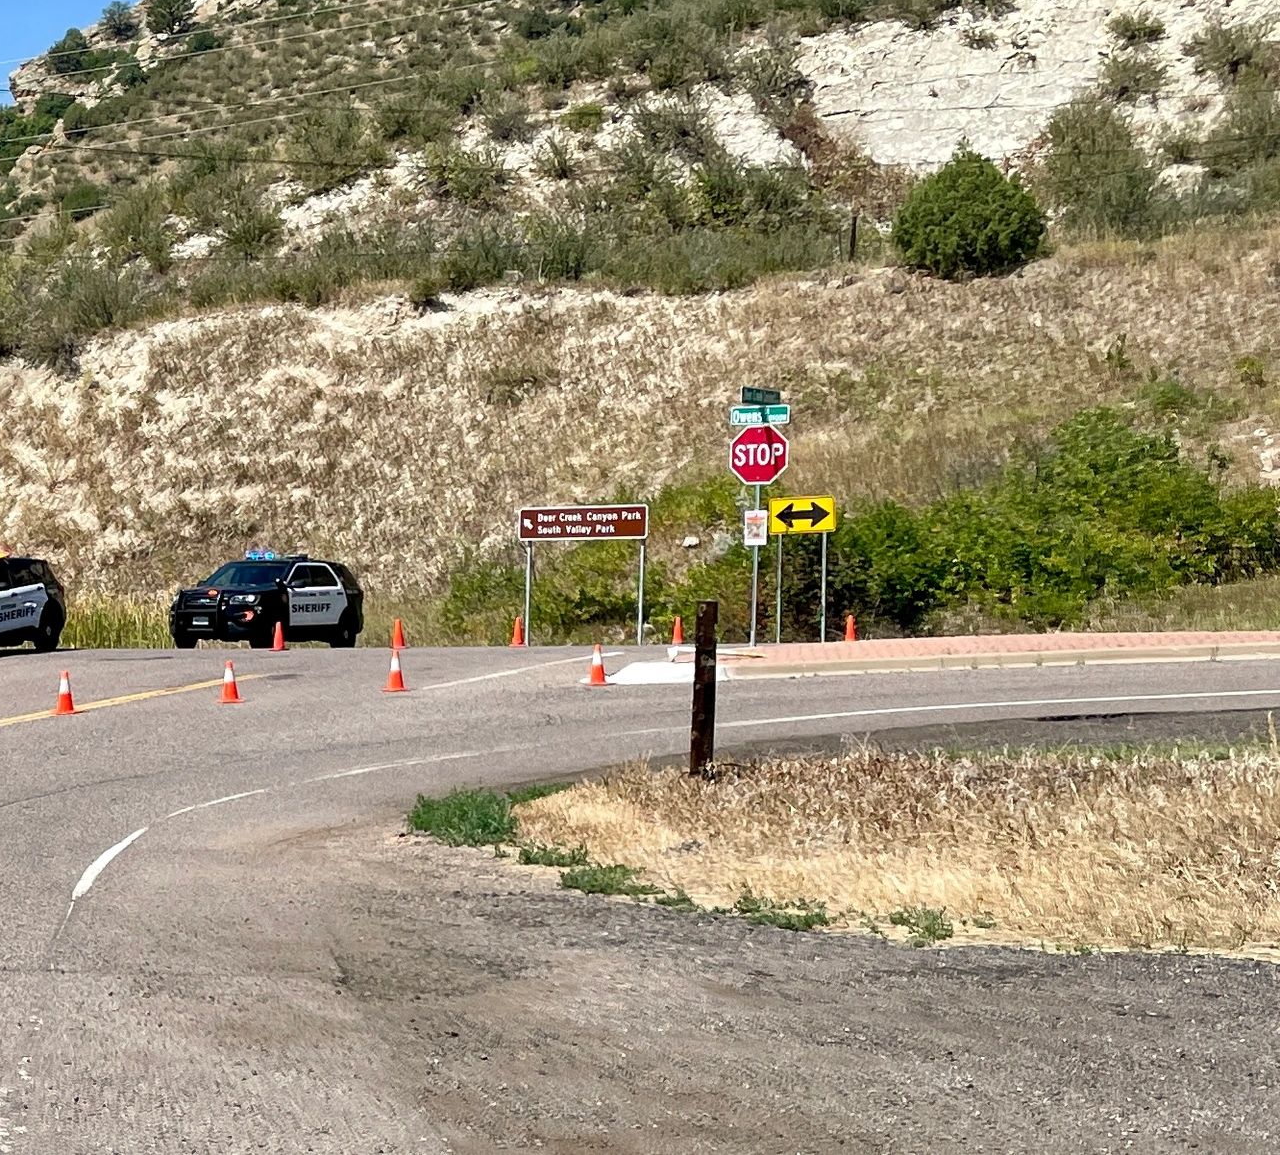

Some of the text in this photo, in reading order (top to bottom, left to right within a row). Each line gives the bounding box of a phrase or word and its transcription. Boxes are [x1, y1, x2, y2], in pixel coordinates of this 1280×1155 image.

[732, 410, 762, 423] Owens
[733, 442, 784, 467] STOP
[537, 510, 642, 523] Deer Creek Canyon Park
[537, 524, 615, 536] South Valley Park
[291, 602, 332, 613] SHERIFF
